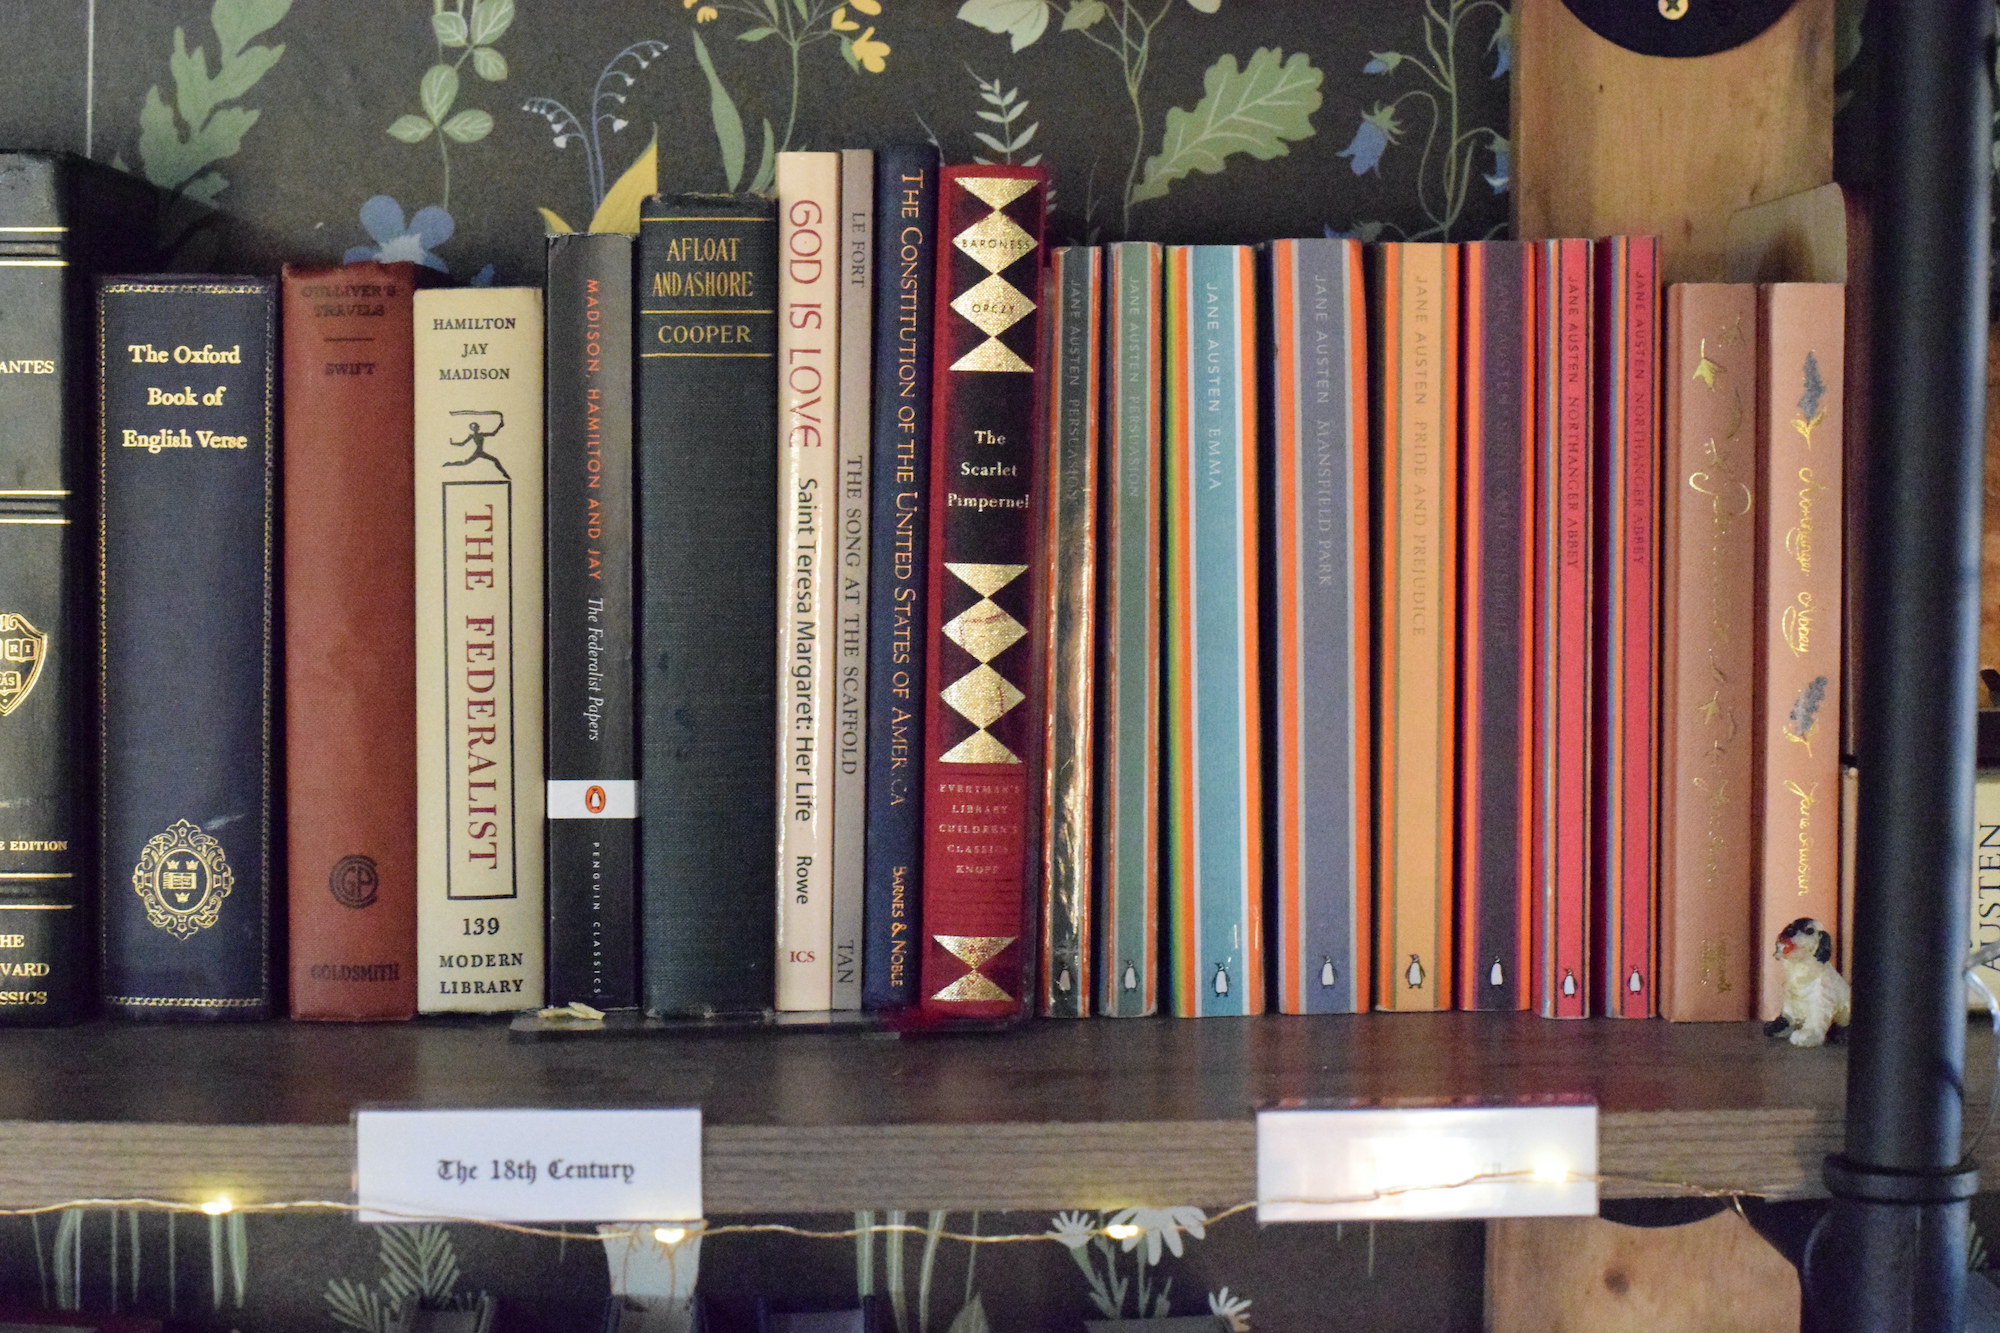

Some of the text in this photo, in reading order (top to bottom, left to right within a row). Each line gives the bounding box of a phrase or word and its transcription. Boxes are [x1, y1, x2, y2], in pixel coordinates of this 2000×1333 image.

[666, 237, 741, 262] AFLOAT
[851, 212, 865, 288] LE FORT
[961, 239, 1031, 251] BARONESS
[653, 271, 754, 297] AND ASHORE
[1070, 279, 1081, 319] JANE
[1635, 271, 1646, 311] JANE
[433, 317, 516, 331] HAMILTON
[789, 200, 822, 448] GOD IS LOVE
[971, 303, 1016, 314] ORCZY
[461, 343, 489, 358] JAY
[657, 325, 752, 343] COOPER
[1634, 319, 1645, 379] AUSTEN
[127, 344, 241, 364] The Oxford
[325, 362, 376, 376] SWIFT
[1069, 326, 1080, 387] AUSTEN
[439, 368, 510, 381] MADISON
[1128, 276, 1141, 497] JANE AUSTEN PERSUASION
[1207, 282, 1222, 490] JANE AUSTEN EMMA
[147, 385, 227, 406] Book of
[122, 429, 248, 454] English Verse
[586, 279, 601, 580] MADISON, HAMILTON AND JAY
[974, 429, 1007, 445] The
[1315, 275, 1332, 586] JANE AUSTEN MANSFIELD PARK
[1567, 276, 1580, 569] JANE AUSTEN NORTHANGER ABBEY
[1412, 276, 1428, 637] JANE AUSTEN PRIDE AND PREJUDICE
[1633, 392, 1645, 507] NORTHANGER
[890, 169, 924, 806] THE CONSTITUTION OF THE UNITED STATES OF AMERCA
[960, 461, 1019, 478] Scarlet
[798, 478, 818, 535] Saint
[947, 492, 1030, 513] Pimpernel
[796, 540, 817, 614] Teresa
[841, 455, 863, 775] THE SONG AT THE SCAFFOLD
[465, 504, 498, 870] THE FEDERALIST
[583, 598, 604, 742] The Federalist Papers
[796, 737, 814, 776] Her
[795, 783, 813, 822] Life
[10, 840, 69, 852] EDITION
[796, 855, 813, 905] Rowe
[462, 917, 501, 936] 139
[592, 842, 602, 995] PENGUIN CLASSICS
[890, 866, 908, 987] BARNES & NOBLE
[310, 963, 400, 982] GOLDSMITH
[439, 953, 524, 968] MODERN
[789, 950, 816, 963] ICS
[837, 940, 855, 984] TAN
[439, 979, 524, 995] LIBRARY
[438, 1158, 636, 1185] The 18th Century
